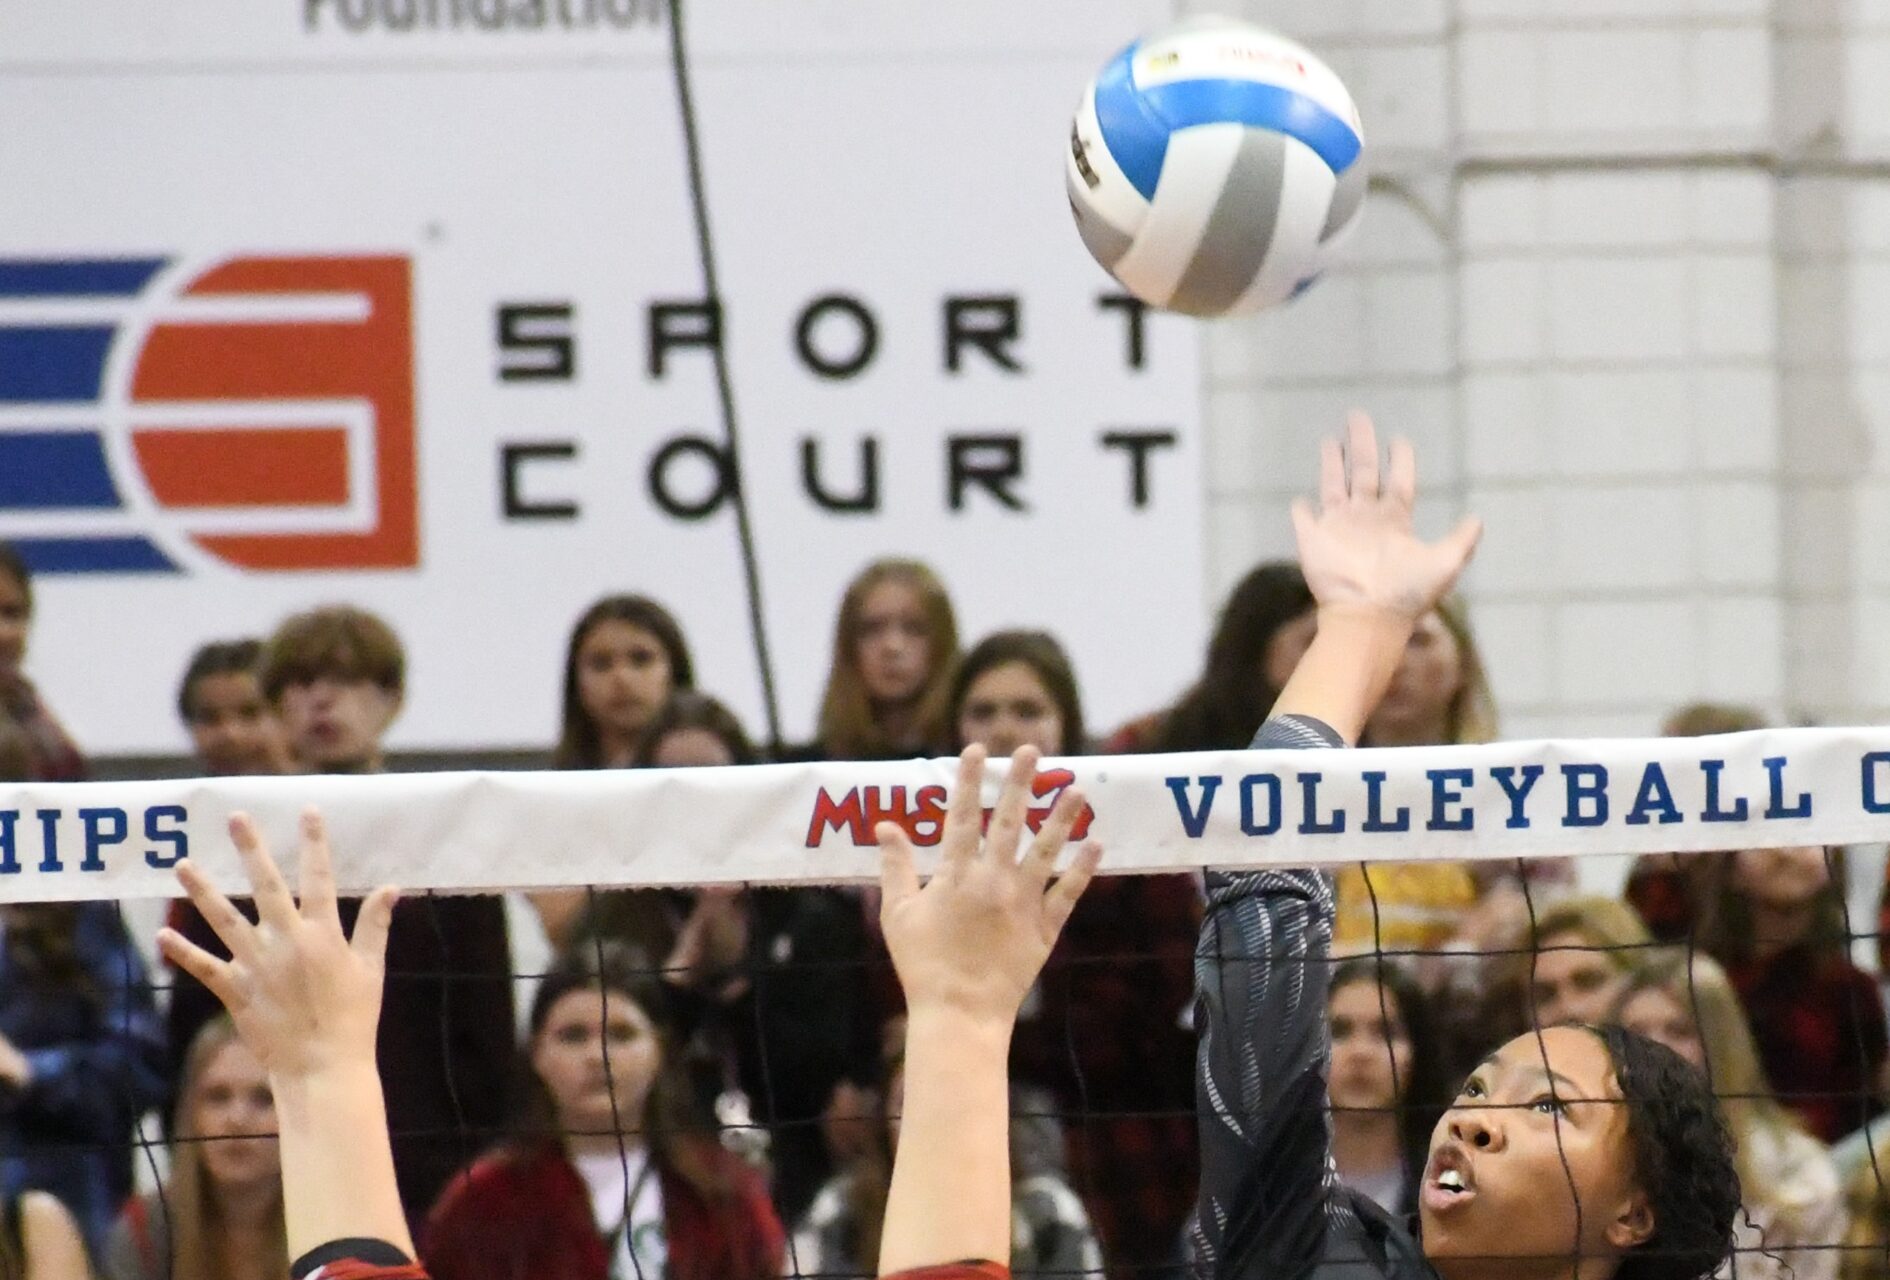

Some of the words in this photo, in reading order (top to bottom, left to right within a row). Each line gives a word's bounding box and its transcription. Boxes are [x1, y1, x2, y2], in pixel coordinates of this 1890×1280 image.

[496, 293, 1150, 380] SPORT
[500, 431, 1177, 521] COURT
[1165, 755, 1813, 838] VOLLEYBALL
